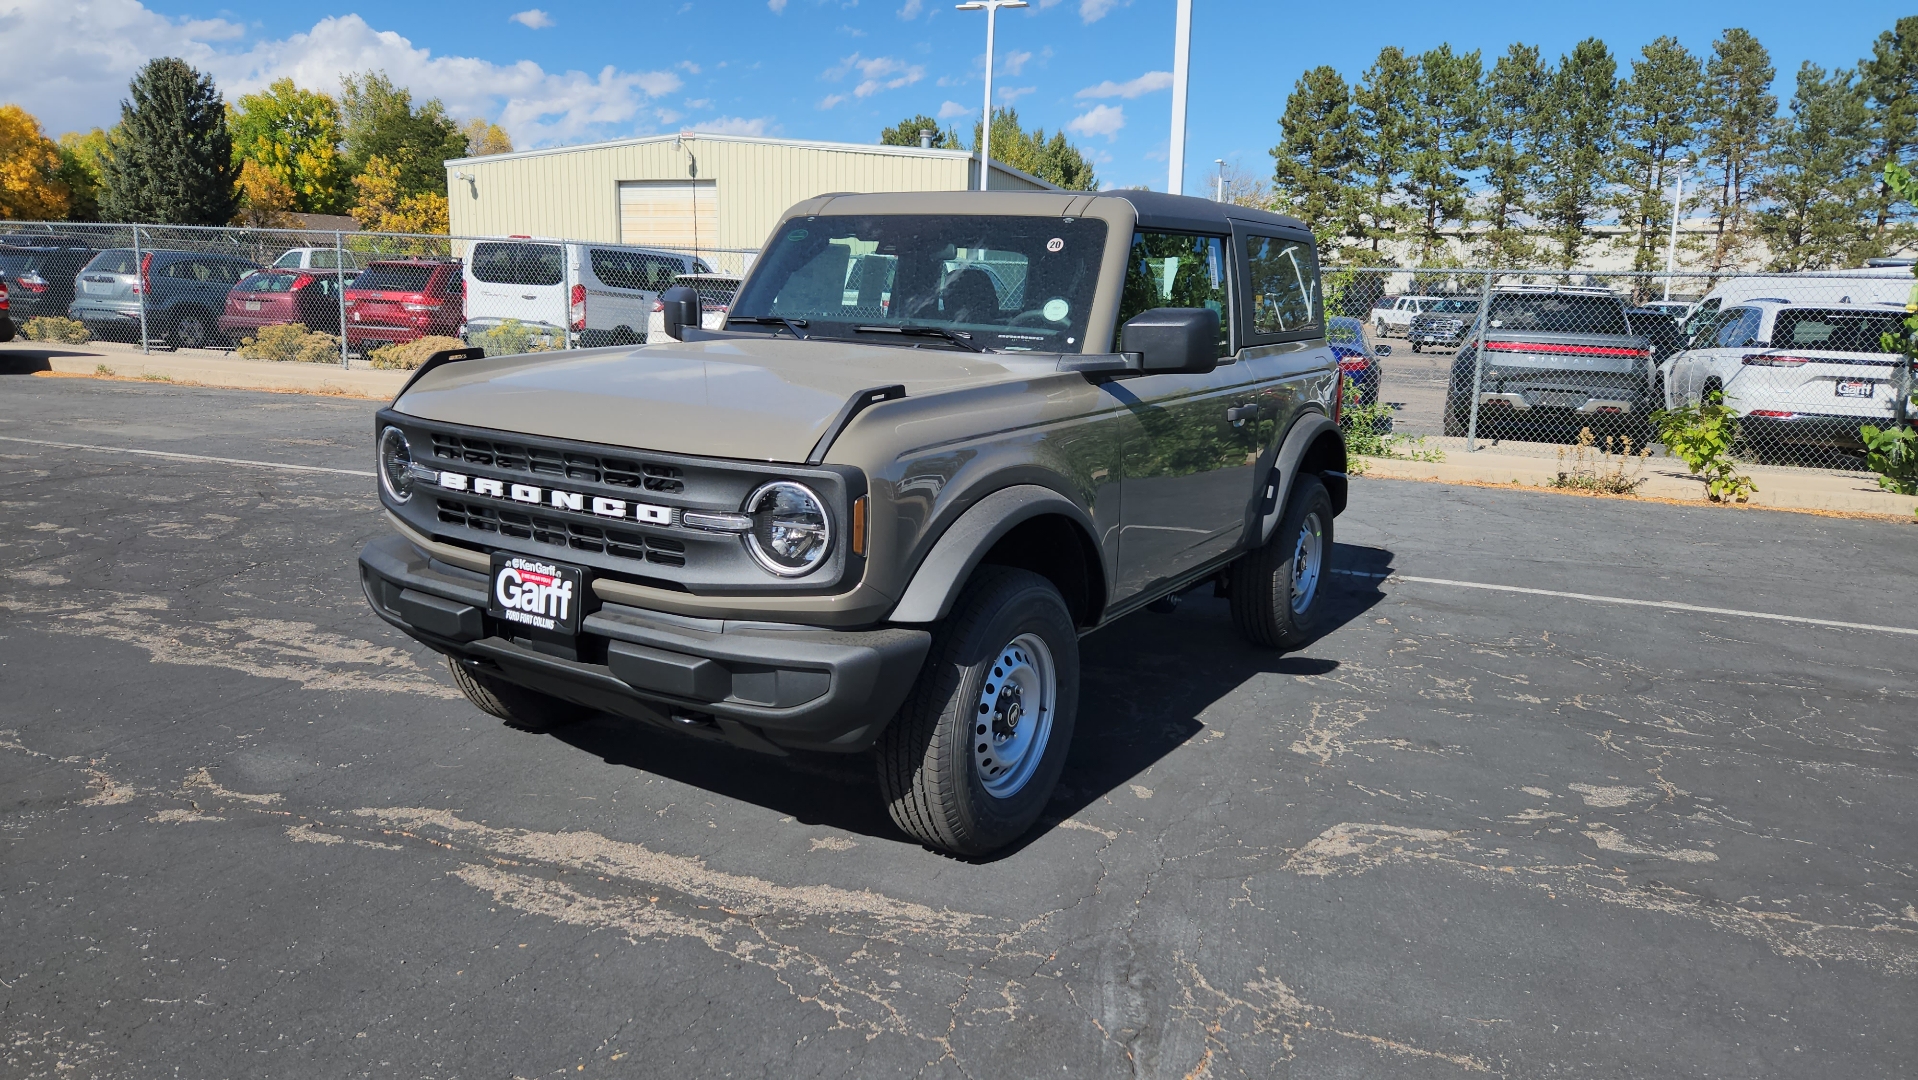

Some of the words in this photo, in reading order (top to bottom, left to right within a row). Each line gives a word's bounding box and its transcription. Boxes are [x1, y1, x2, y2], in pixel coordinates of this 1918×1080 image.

[1050, 241, 1061, 249] 20
[1528, 356, 1594, 366] RIVIAN
[440, 471, 673, 525] BRONCO
[497, 568, 572, 620] Garff
[506, 610, 520, 621] FORD
[520, 612, 533, 625] FORT
[533, 616, 554, 630] COLLINS
